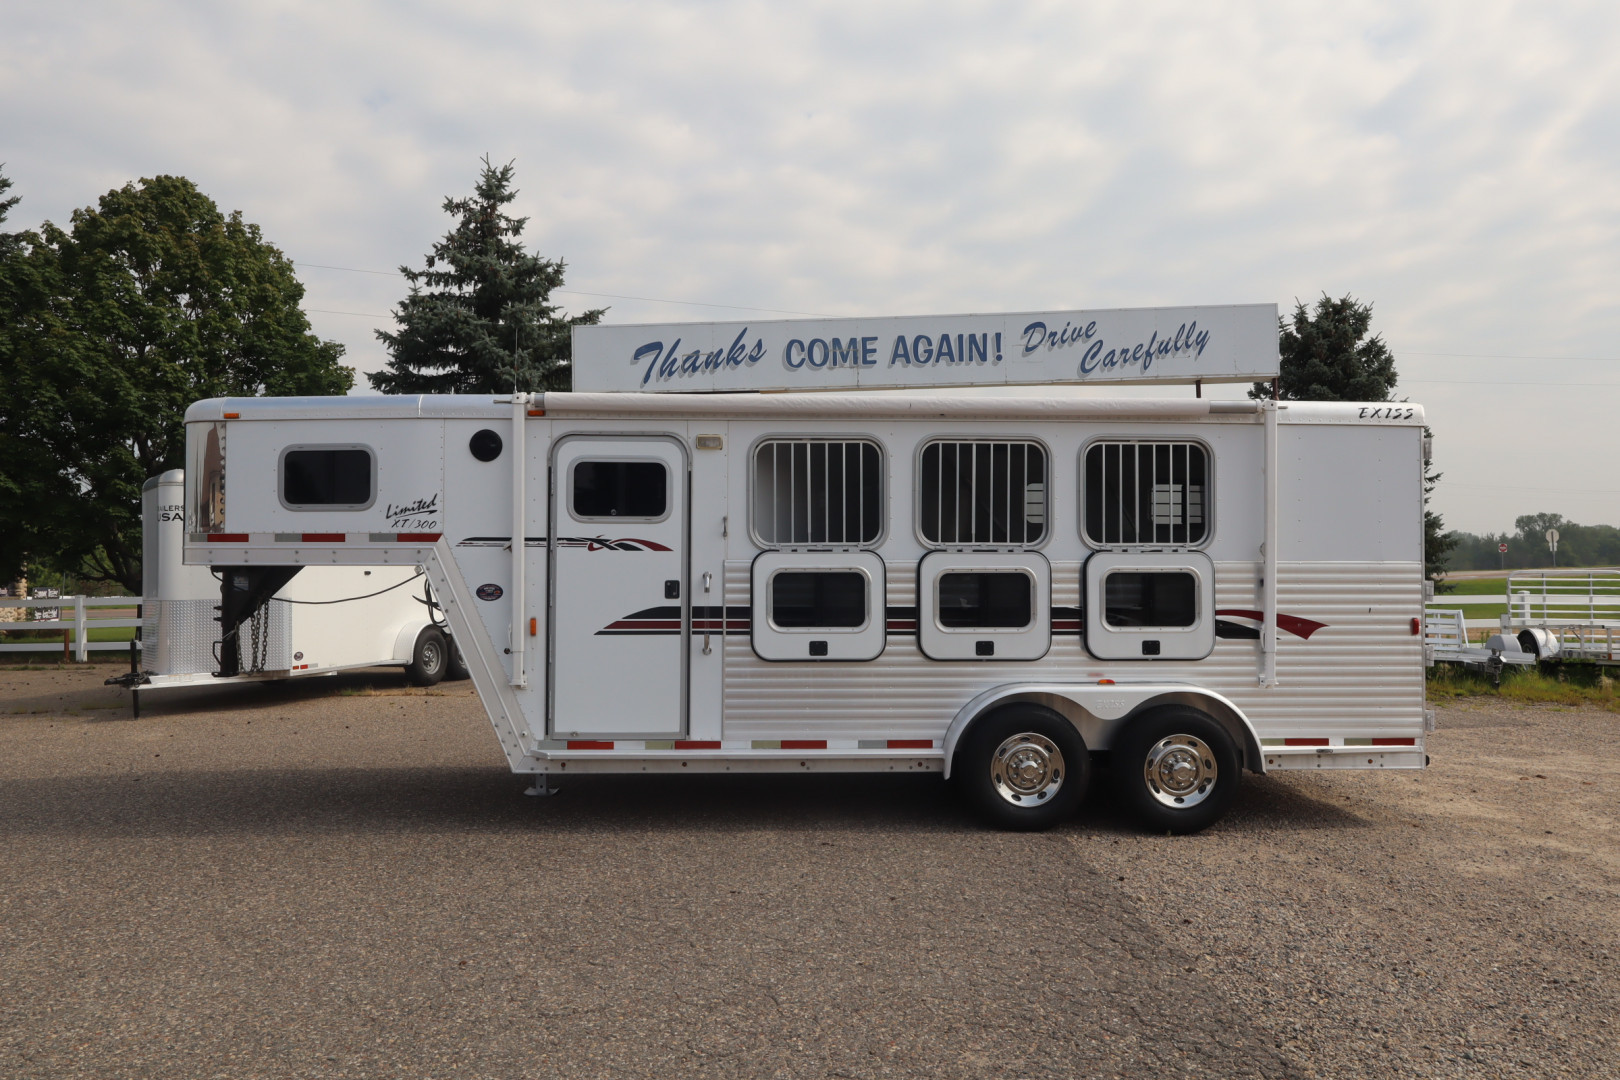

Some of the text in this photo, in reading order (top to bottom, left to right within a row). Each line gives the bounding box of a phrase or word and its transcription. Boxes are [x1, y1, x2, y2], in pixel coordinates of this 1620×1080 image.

[1023, 320, 1097, 352] Drive
[1080, 320, 1211, 374] Carefully
[633, 327, 1003, 385] Thanks COME AGAIN!
[1358, 407, 1413, 420] EXISS
[386, 493, 437, 519] Limited
[392, 519, 437, 529] XT/300
